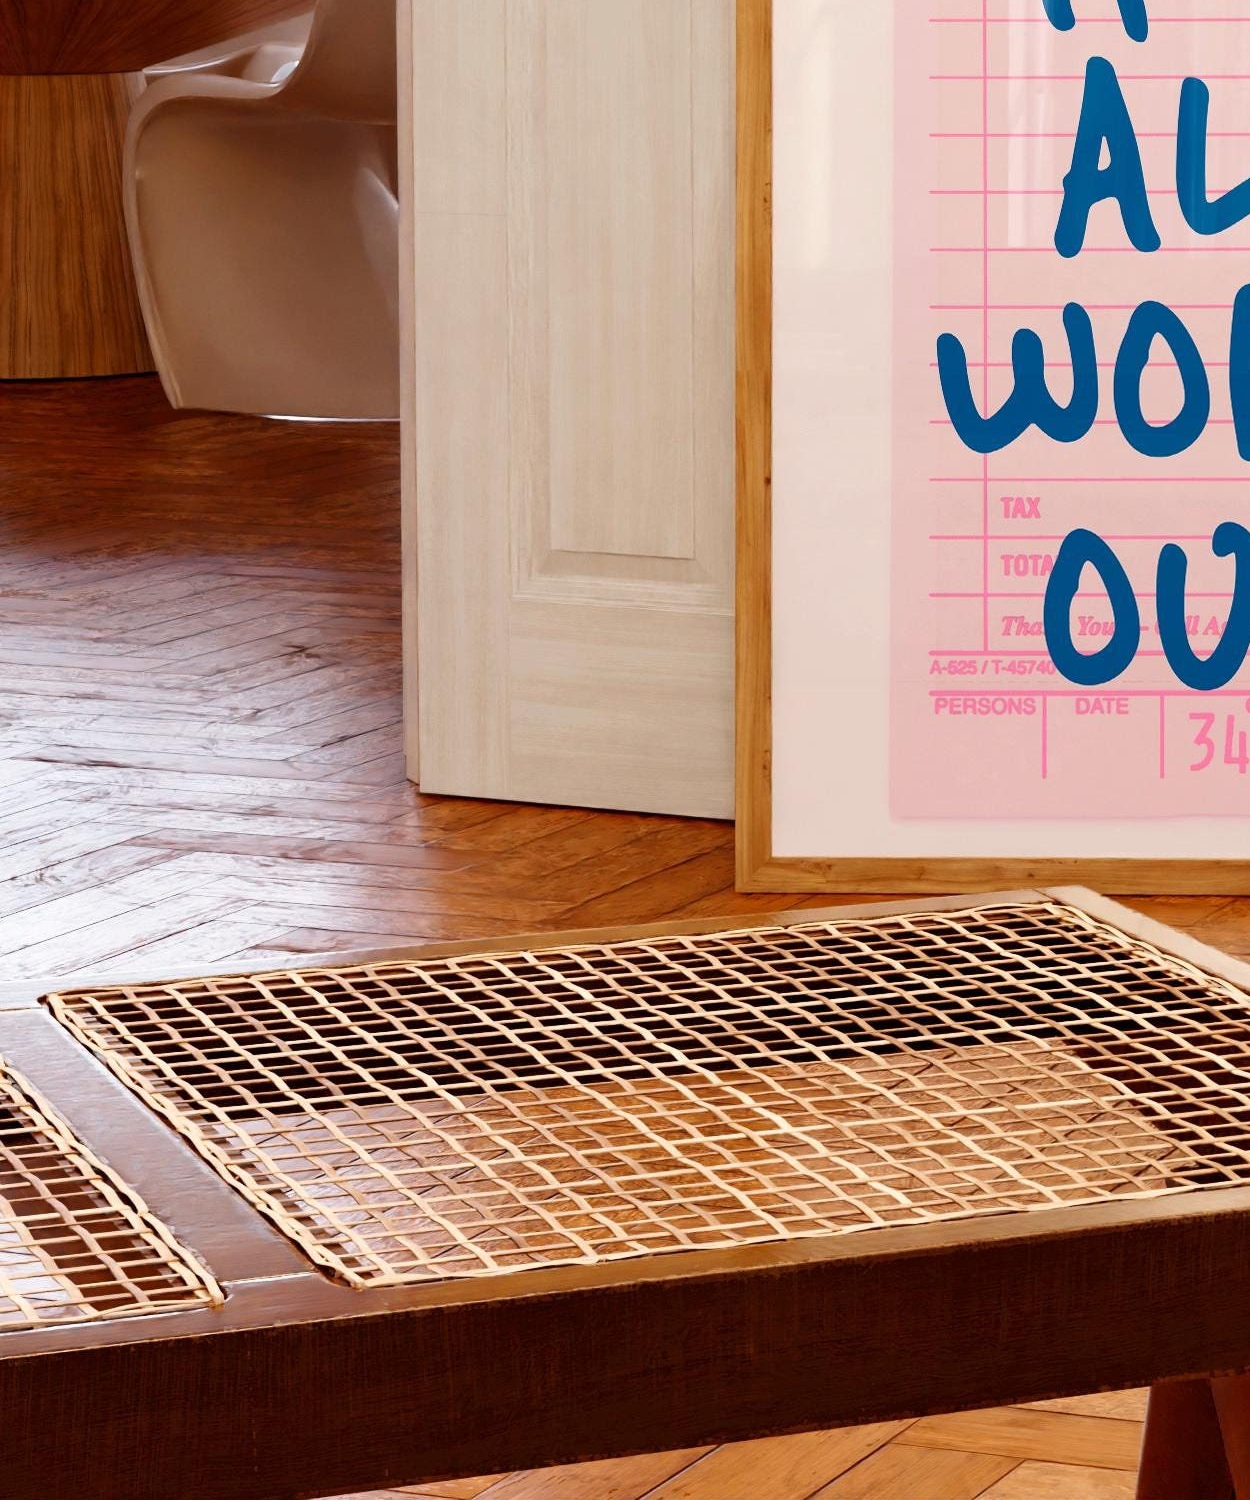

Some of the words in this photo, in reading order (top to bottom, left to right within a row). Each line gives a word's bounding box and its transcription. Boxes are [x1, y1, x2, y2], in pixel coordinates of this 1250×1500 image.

[1000, 496, 1041, 519] TAX
[1000, 554, 1057, 577] TOTA
[1001, 615, 1044, 636] Tha
[929, 659, 977, 675] A-525
[934, 696, 1036, 715] PERSONS
[1075, 696, 1129, 714] DATE
